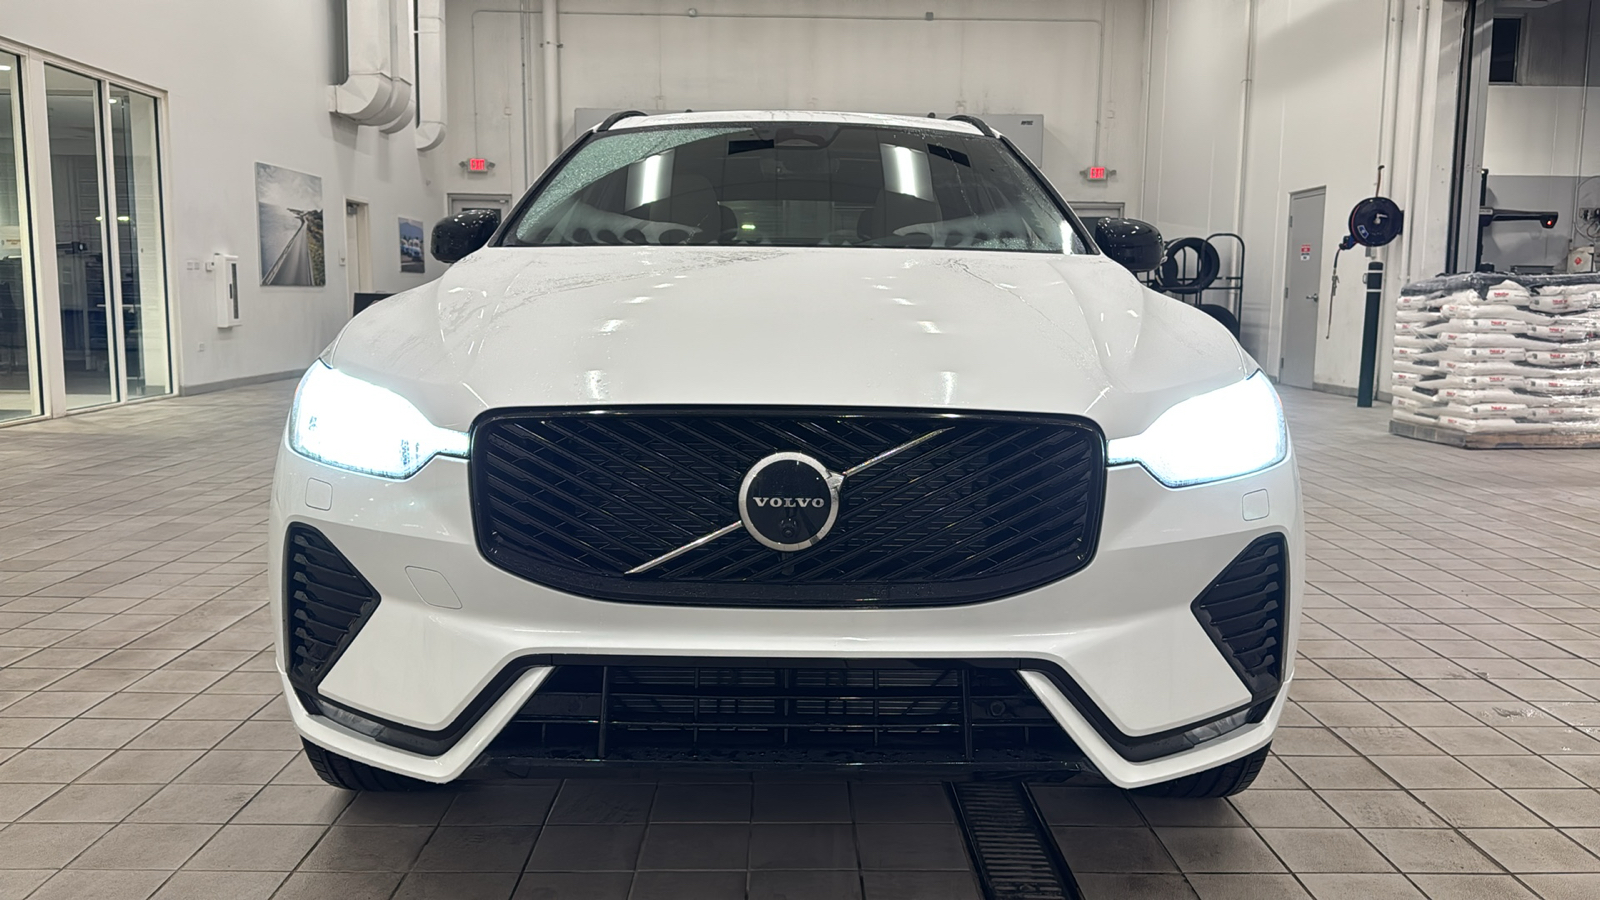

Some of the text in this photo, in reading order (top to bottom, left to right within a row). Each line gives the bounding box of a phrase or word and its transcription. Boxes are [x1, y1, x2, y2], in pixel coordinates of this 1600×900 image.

[470, 159, 485, 170] EXIT
[1090, 167, 1105, 178] EXIT
[753, 497, 824, 508] VOLVO
